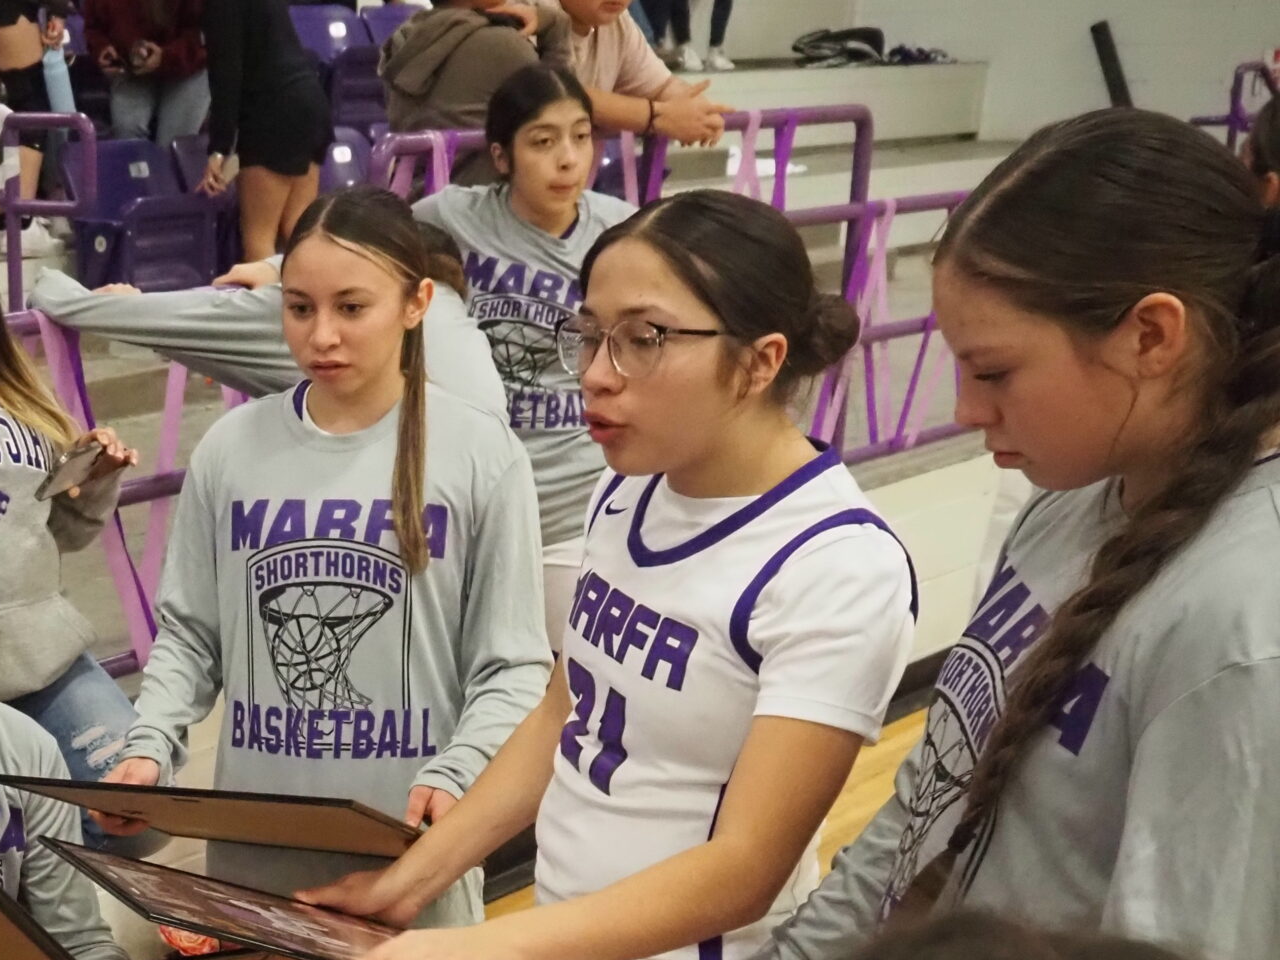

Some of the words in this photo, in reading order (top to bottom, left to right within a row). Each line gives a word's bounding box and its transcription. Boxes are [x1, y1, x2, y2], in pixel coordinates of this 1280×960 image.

[254, 550, 403, 595] SHORTHORNS
[231, 700, 437, 760] BASKETBALL
[560, 657, 628, 796] 21
